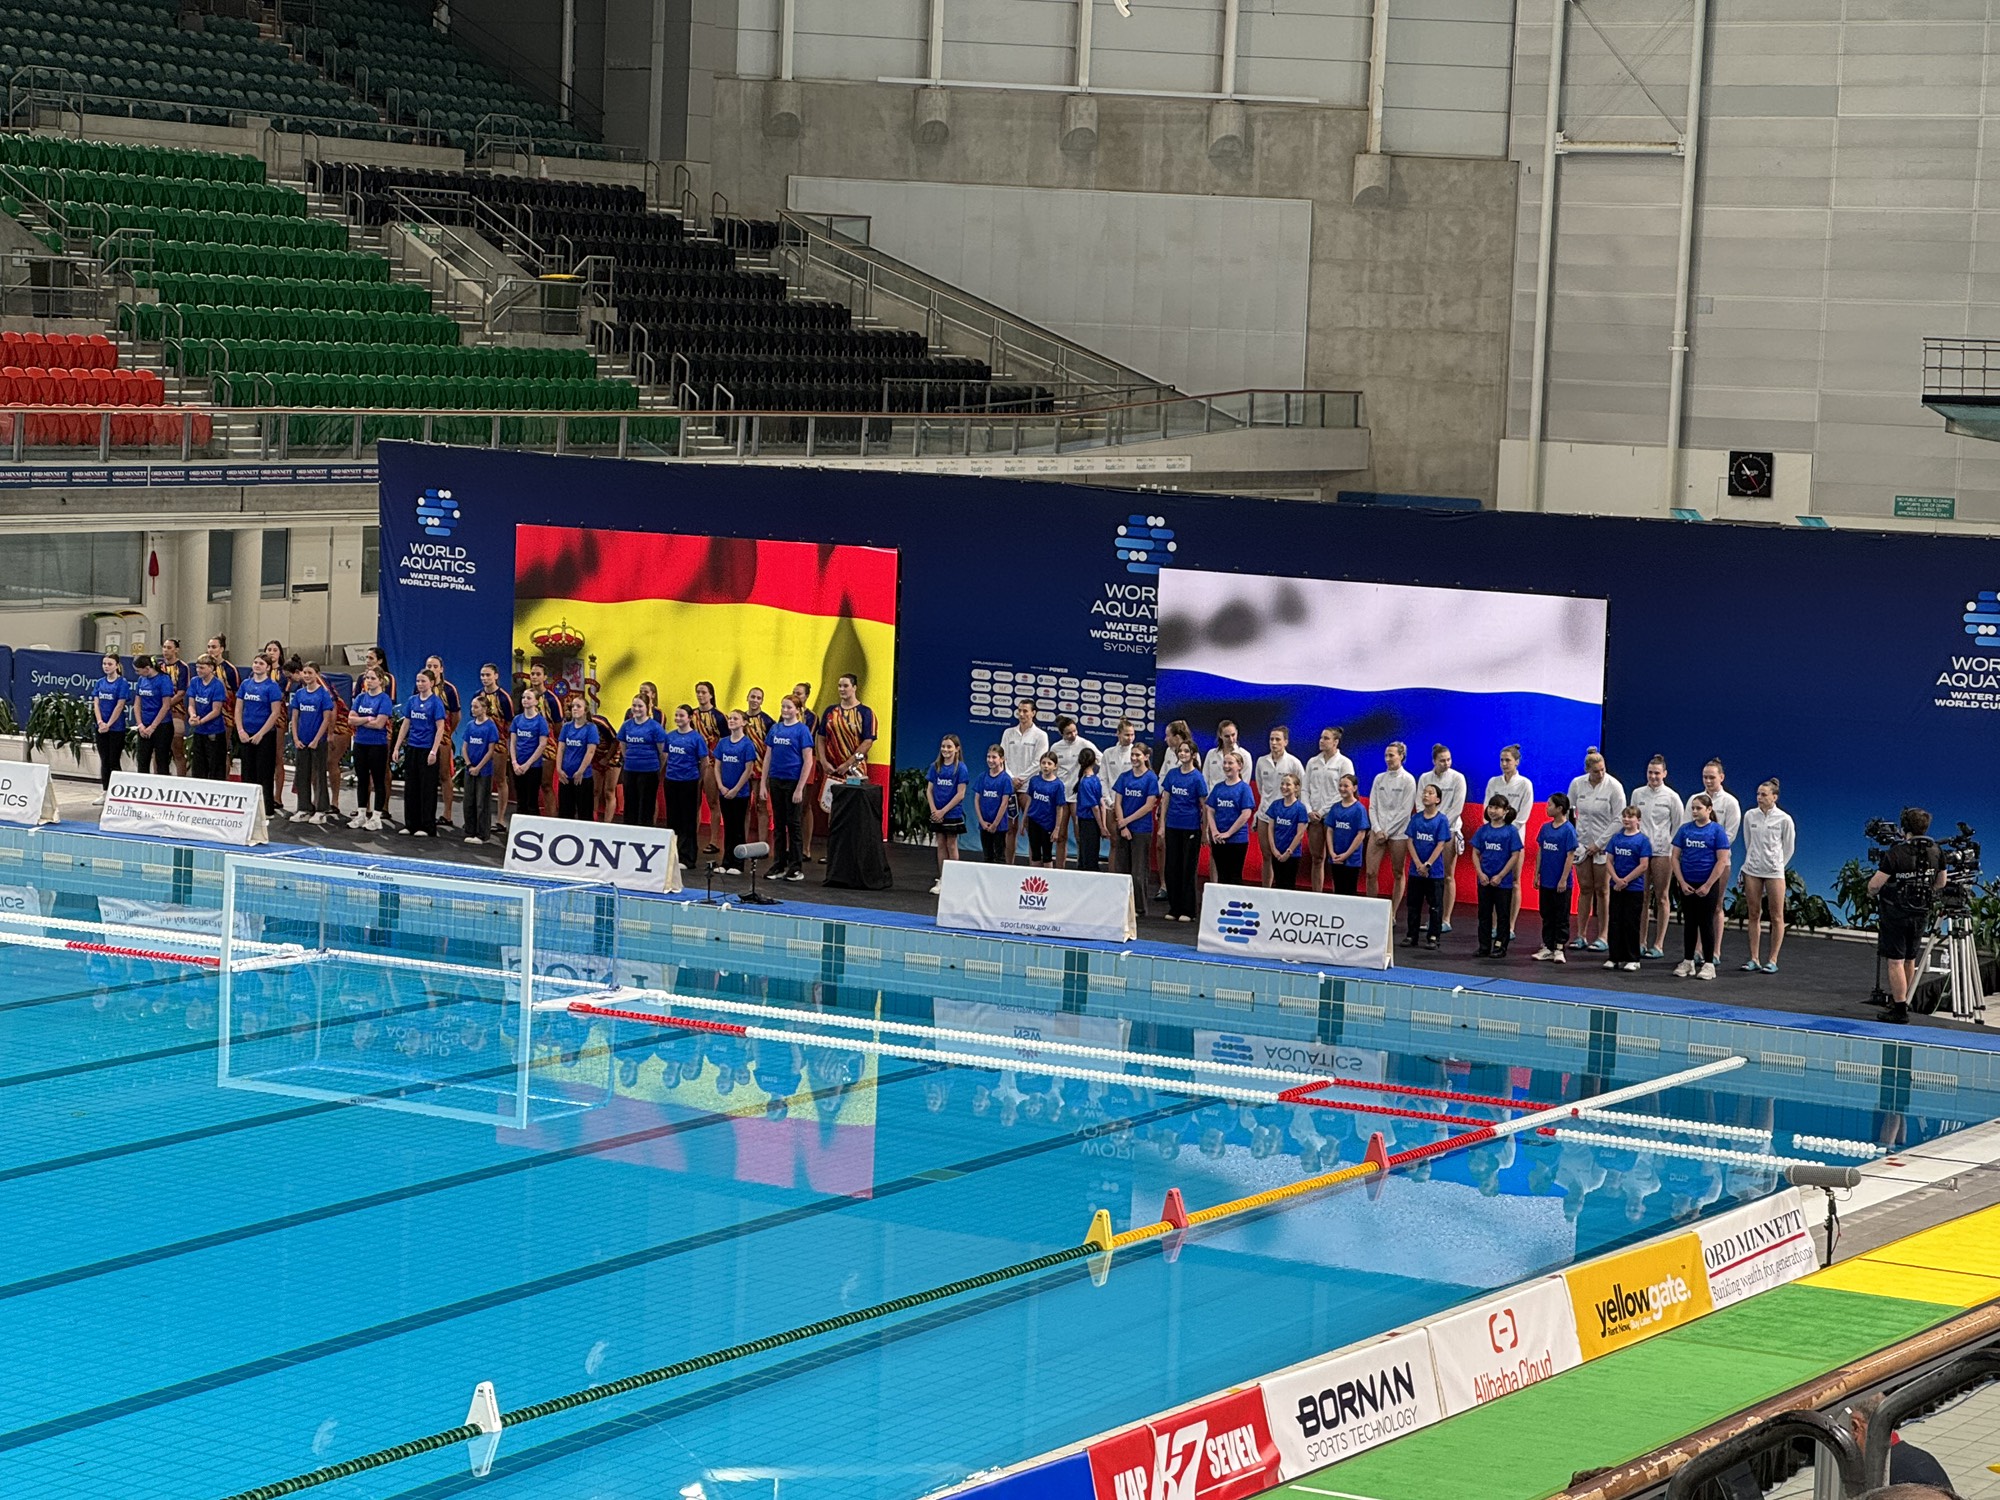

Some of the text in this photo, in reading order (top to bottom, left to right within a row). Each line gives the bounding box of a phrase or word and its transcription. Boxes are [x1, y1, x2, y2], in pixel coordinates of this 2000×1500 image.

[409, 542, 466, 559] WORLD
[400, 556, 476, 574] AQUATICS
[399, 578, 476, 592] WORLD CUP FINAL
[410, 572, 465, 583] WATER POLO
[1104, 583, 1156, 601] WOR
[1090, 600, 1158, 619] AQUAT
[1090, 629, 1134, 641] WORLD
[1105, 621, 1148, 633] WATER
[1103, 642, 1150, 654] SYDNEY
[1952, 656, 2000, 672] WOR
[1936, 672, 2000, 689] AQUA
[1934, 699, 2000, 710] WORLD CU
[1950, 691, 1994, 701] WATER
[110, 784, 248, 810] ORD MINNETT
[106, 805, 243, 829] Building wealth for generations
[511, 830, 666, 873] SONY
[365, 873, 394, 882] Malmsten
[1019, 894, 1048, 907] NSW
[1000, 921, 1061, 932] sport.nsw.gov.au
[1271, 910, 1345, 930] WORLD
[1268, 928, 1370, 949] AQUATICS
[1704, 1208, 1802, 1270] ORD MINNETT
[1711, 1246, 1813, 1302] Building wealth for generations
[1474, 1349, 1552, 1405] Alibaba Cloud
[1296, 1361, 1415, 1438] BORNAN
[1307, 1405, 1418, 1462] SPORTS TECHNOLOGY
[1113, 1465, 1148, 1500] KAP
[1206, 1423, 1262, 1480] SEVEN
